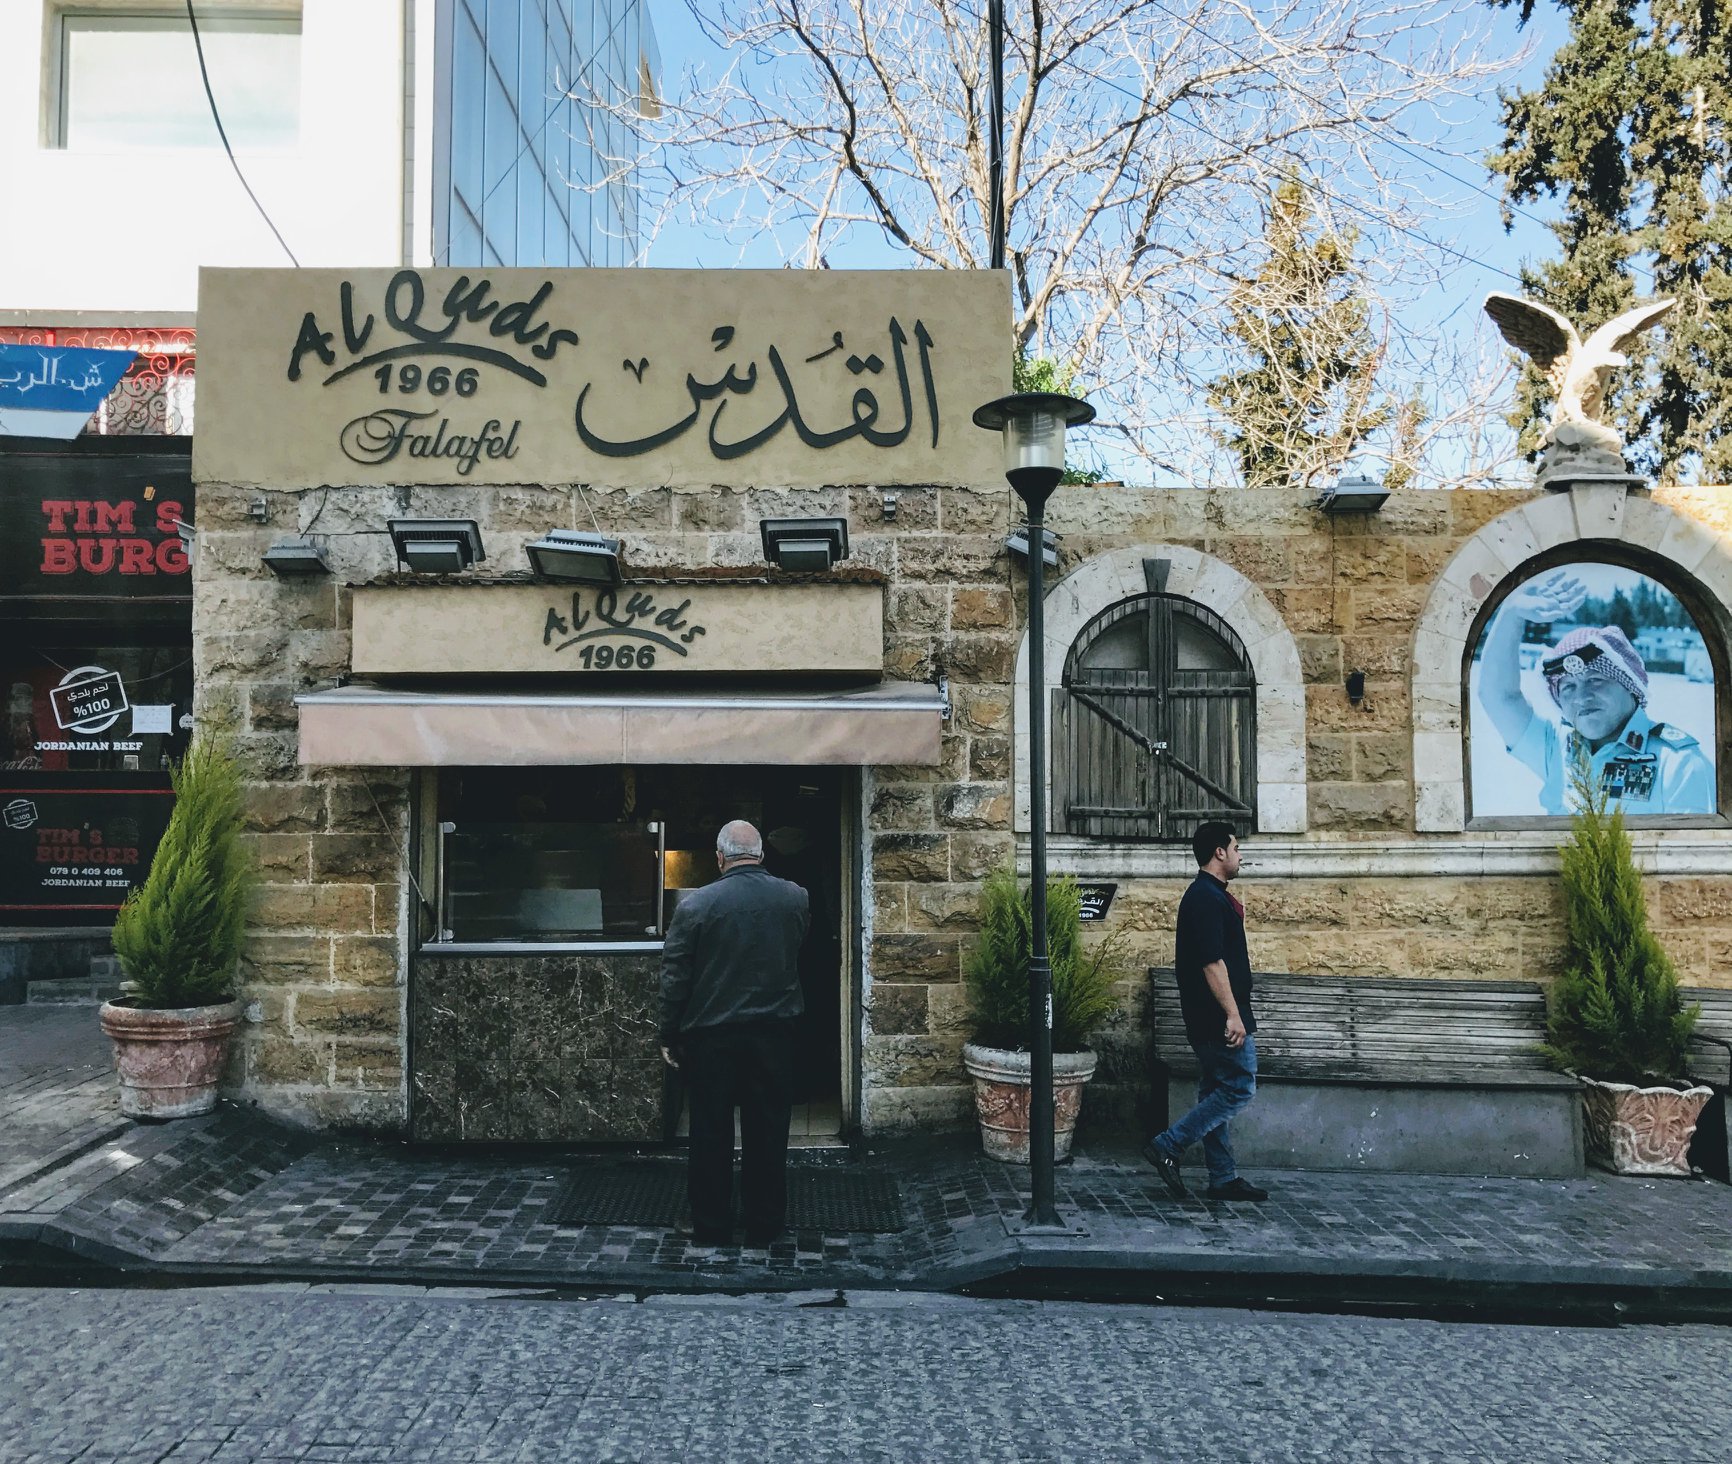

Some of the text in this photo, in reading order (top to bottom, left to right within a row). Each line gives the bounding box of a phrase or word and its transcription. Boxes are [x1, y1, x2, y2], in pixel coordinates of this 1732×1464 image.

[287, 269, 579, 382] Al Quds
[374, 363, 480, 398] 1966
[340, 408, 521, 475] Falafel
[40, 537, 192, 575] BURG
[543, 588, 706, 646] Al Quds
[579, 644, 656, 670] 1966
[34, 741, 143, 751] JORDANIAN BEEF
[35, 846, 139, 864] BURGER
[41, 879, 103, 887] JORDANIAN
[81, 867, 101, 875] 409
[104, 867, 123, 876] 406
